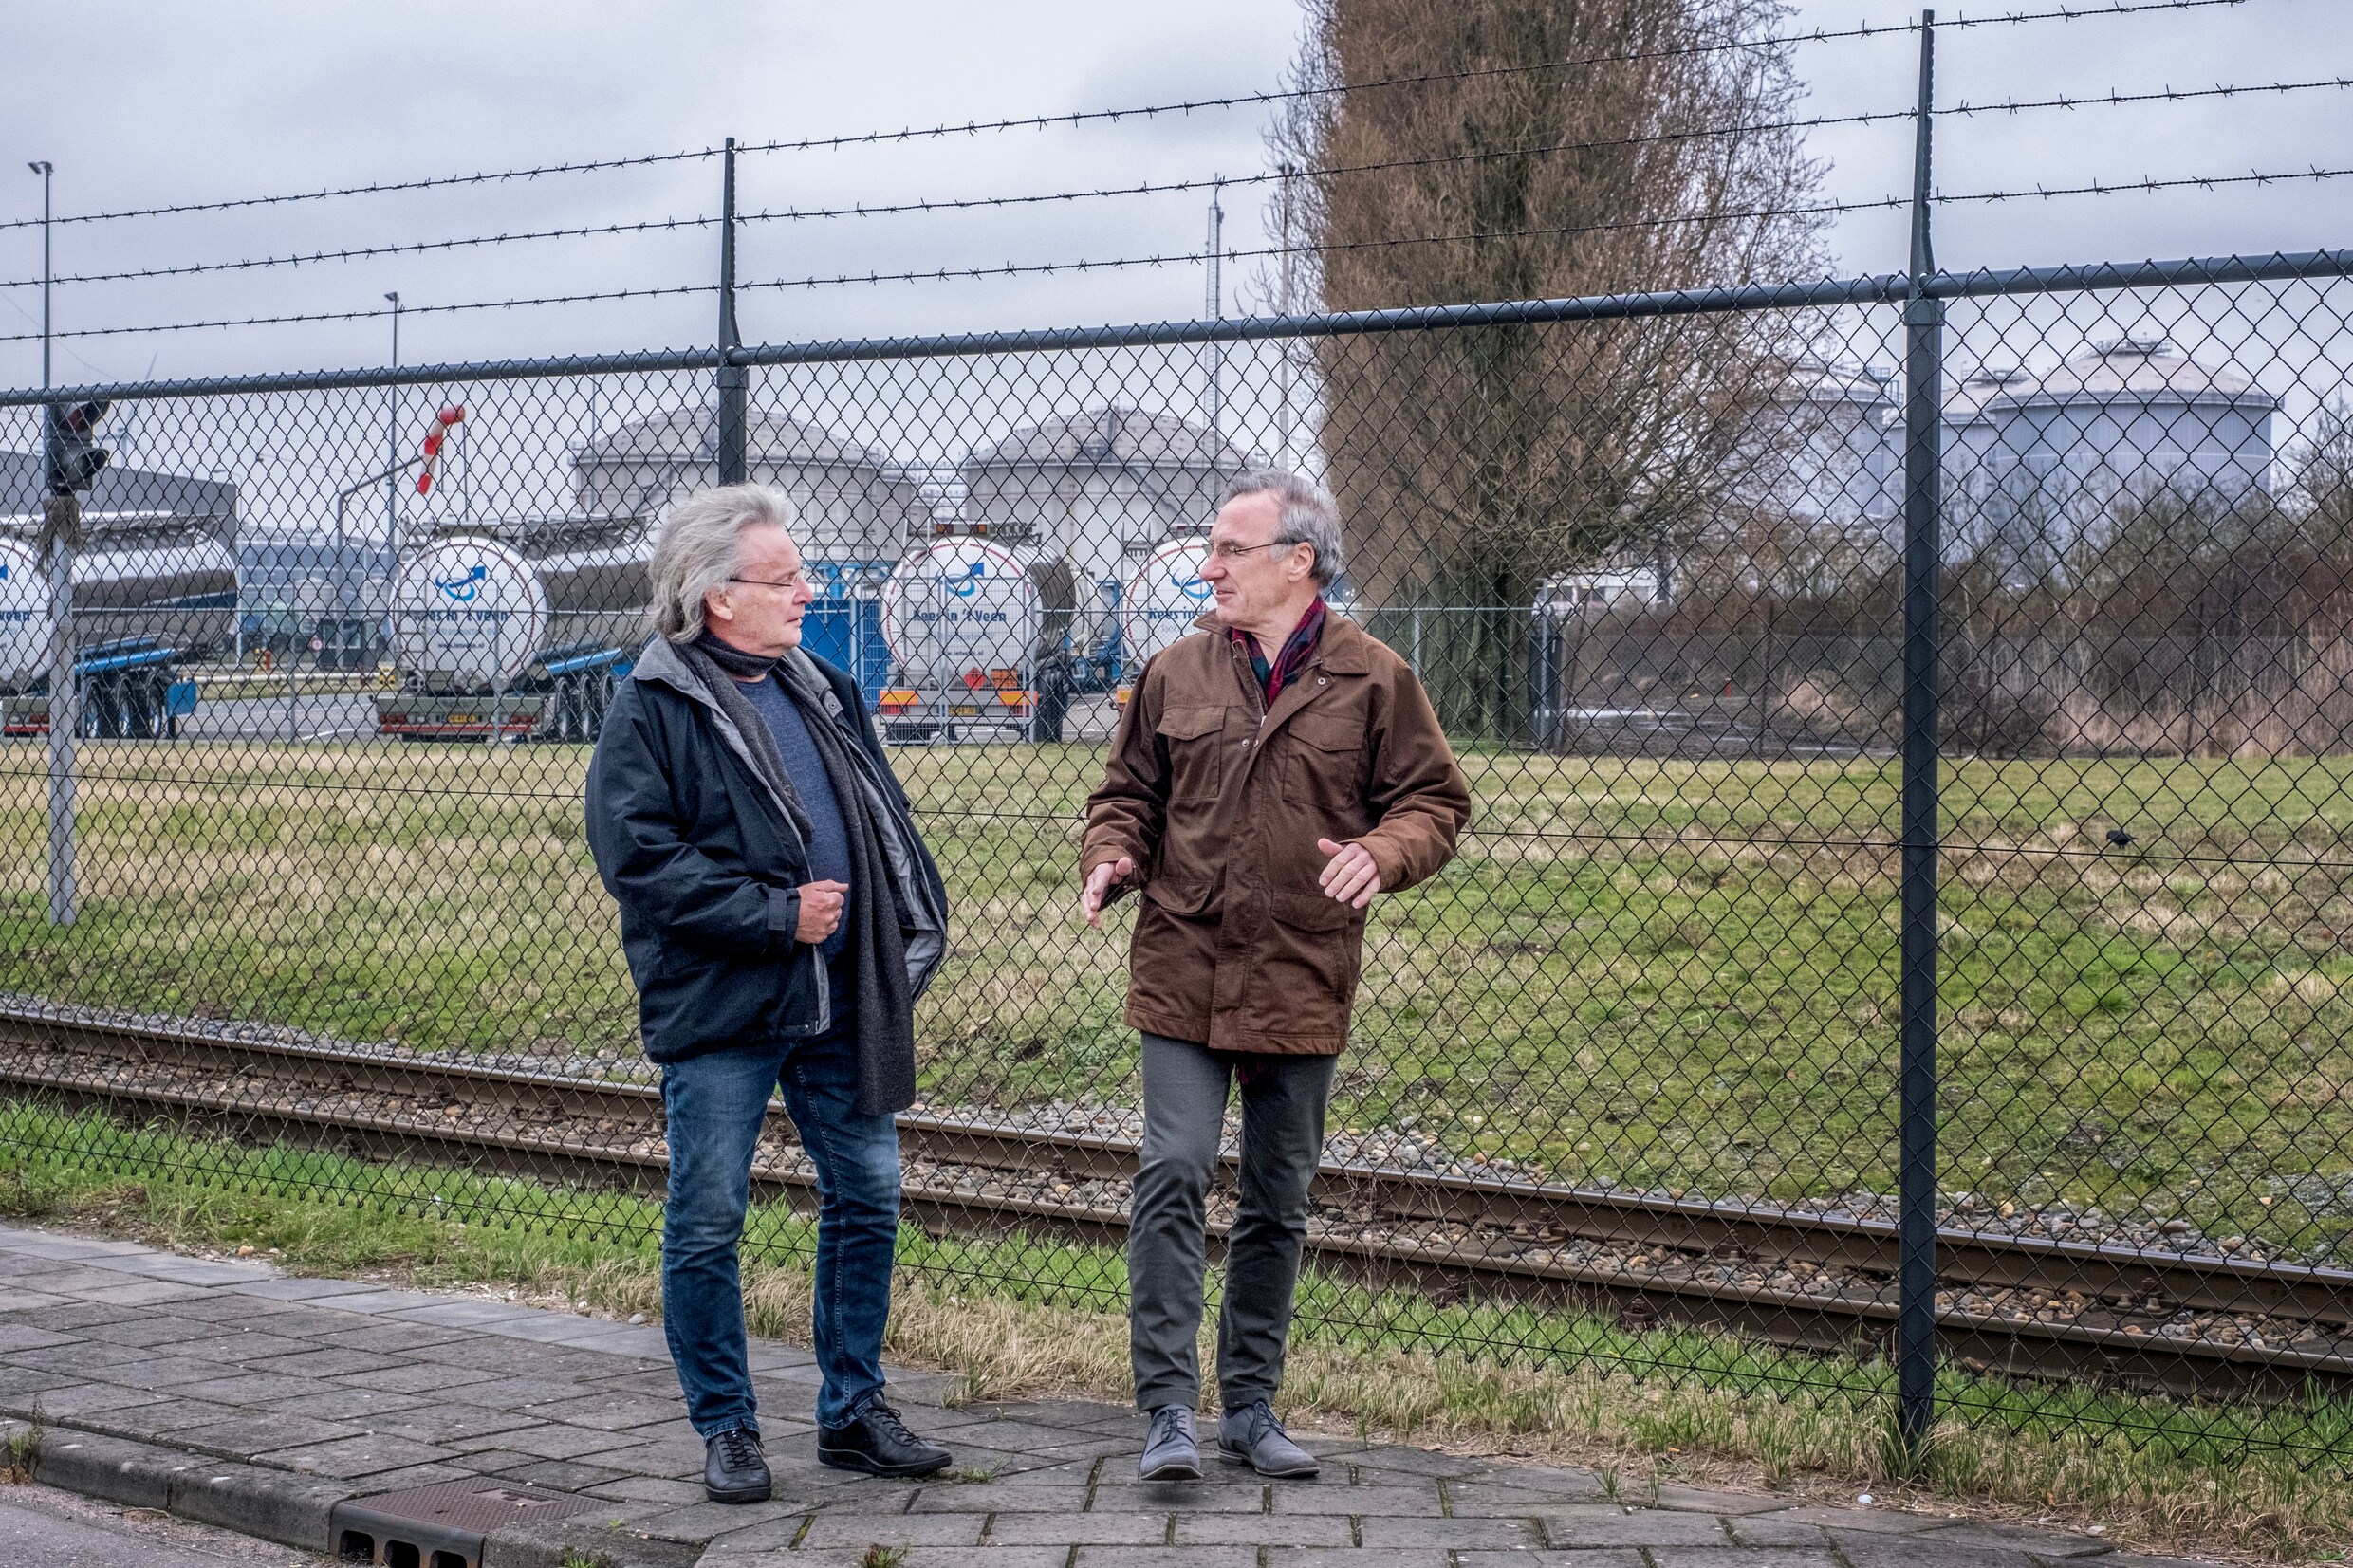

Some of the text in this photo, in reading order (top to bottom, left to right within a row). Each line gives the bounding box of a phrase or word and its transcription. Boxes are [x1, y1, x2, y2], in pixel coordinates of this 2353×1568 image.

[414, 610, 442, 621] Kes
[975, 610, 1007, 621] Veen
[1183, 605, 1195, 619] in
